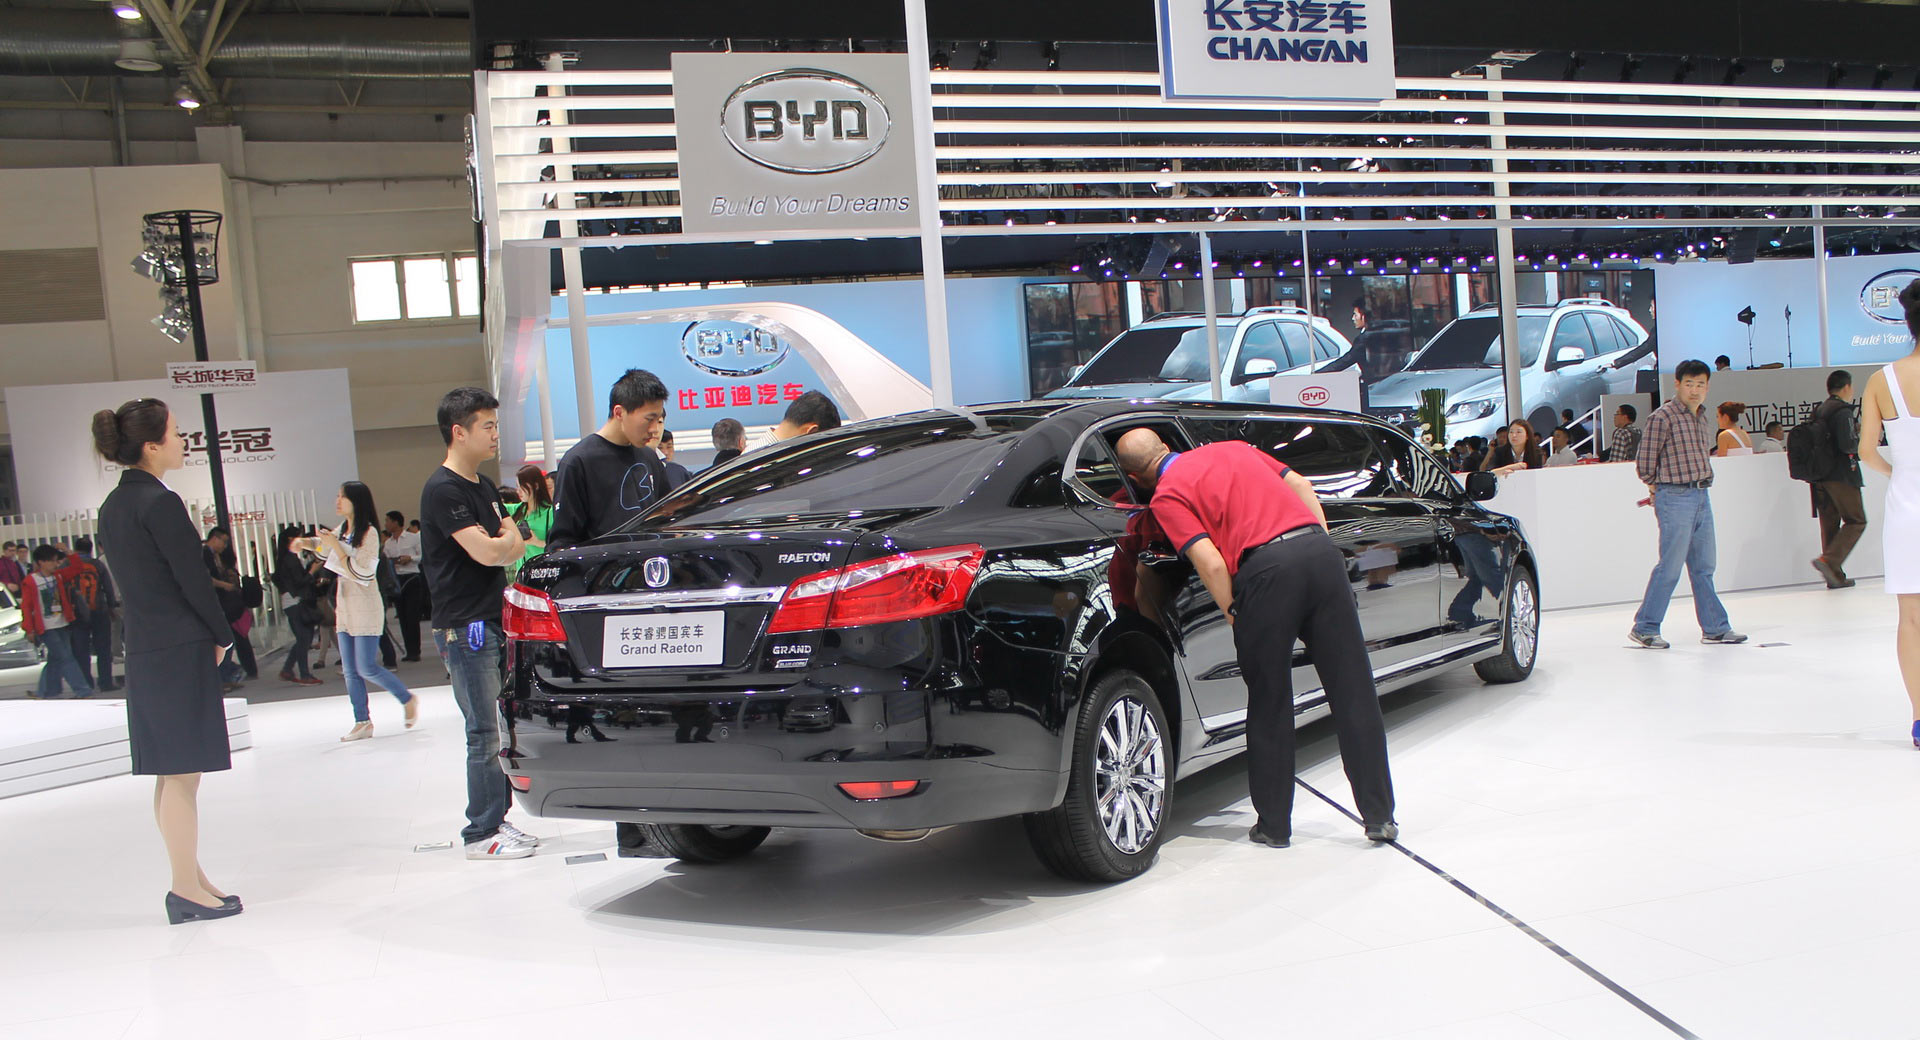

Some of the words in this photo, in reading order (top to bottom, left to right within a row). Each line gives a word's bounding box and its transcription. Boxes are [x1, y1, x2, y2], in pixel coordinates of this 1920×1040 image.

[1203, 0, 1367, 34] 长安汽车
[1206, 36, 1368, 63] CHANGAN
[744, 100, 870, 141] BYD
[710, 195, 768, 216] Build
[774, 194, 824, 215] Your
[826, 193, 910, 213] Dreams
[696, 328, 778, 357] BYD
[1851, 334, 1881, 346] Build
[1883, 333, 1908, 345] Your
[171, 368, 256, 384] 长城华冠
[678, 382, 804, 411] 比亚迪汽车
[1302, 391, 1326, 401] BYD
[778, 552, 831, 564] RAETON
[620, 624, 704, 641] 长安睿骋国宾车
[620, 643, 657, 655] Grand
[660, 642, 703, 654] Raeton
[772, 645, 812, 655] GRAND
